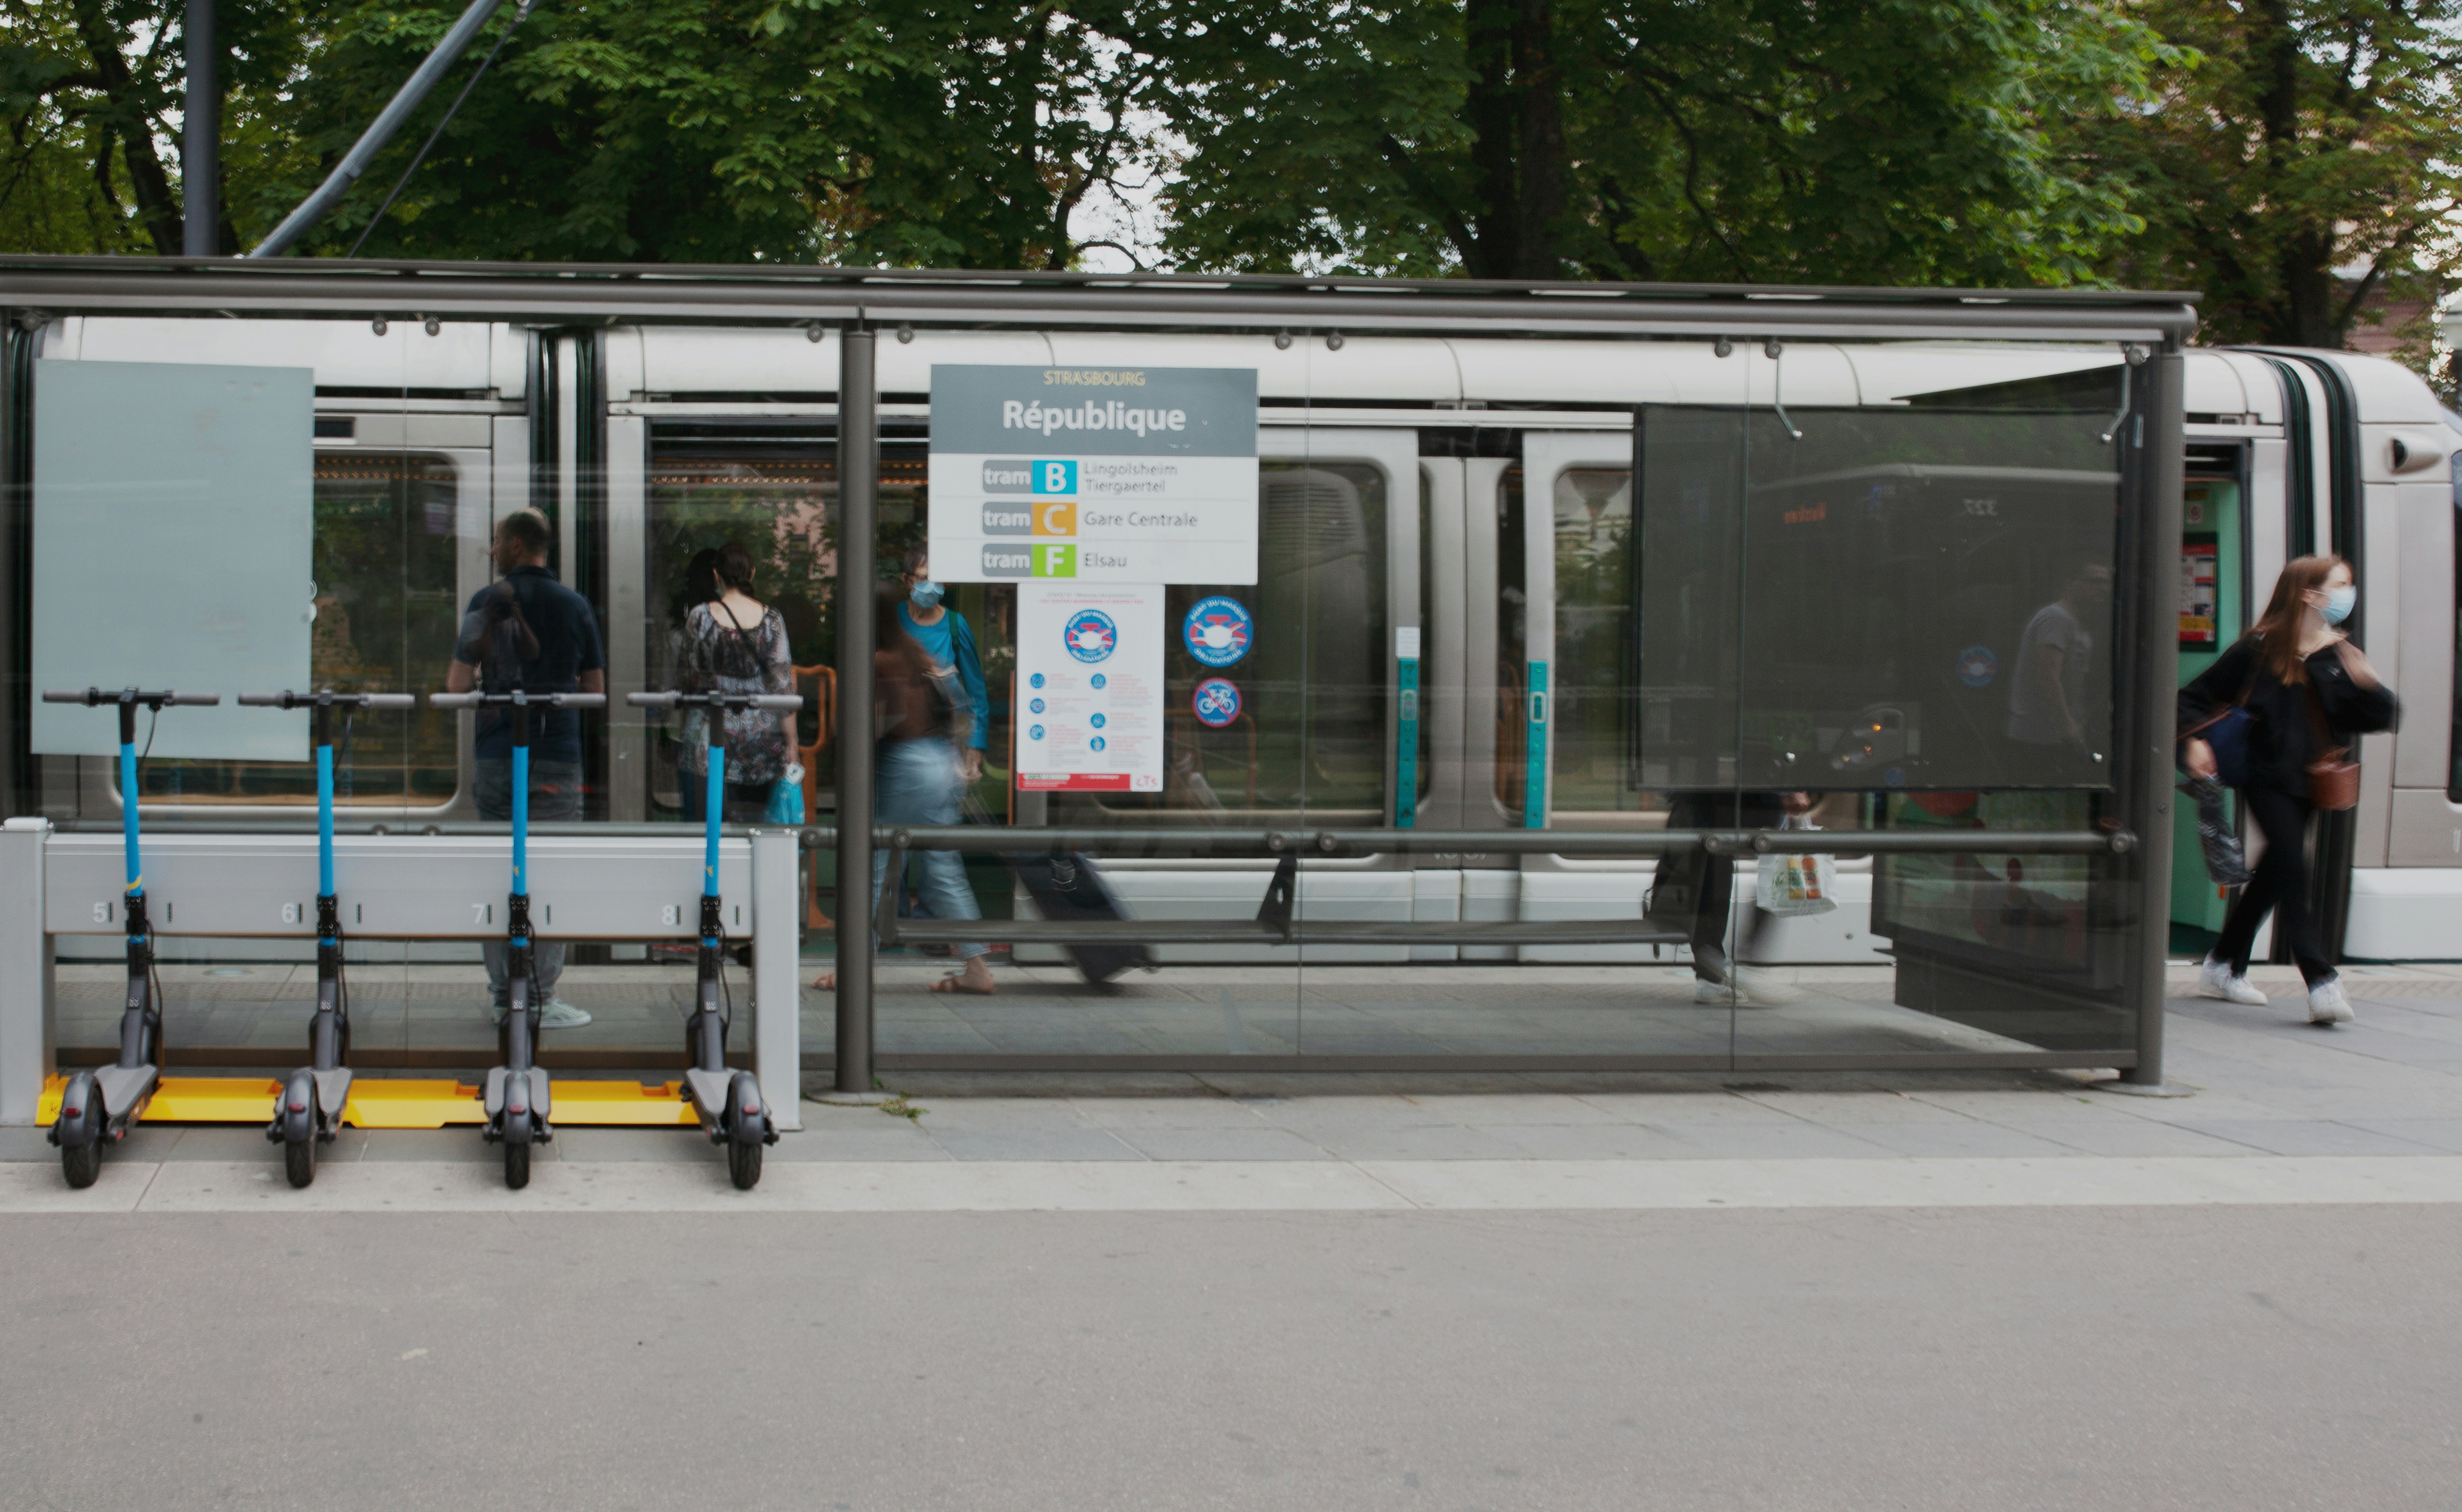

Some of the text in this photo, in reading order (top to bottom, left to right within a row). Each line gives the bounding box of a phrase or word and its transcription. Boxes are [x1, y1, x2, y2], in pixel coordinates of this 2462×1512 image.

[1043, 371, 1146, 386] STRASBOURG
[1003, 400, 1187, 438] République
[984, 463, 1066, 492] tram B
[1085, 462, 1178, 478] Lingolsheim
[1085, 479, 1165, 494] Tiergaertel
[983, 504, 1198, 534] tram C Gare Centrale
[983, 546, 1127, 576] tram F Elsau
[93, 902, 107, 923] 5
[281, 902, 296, 923] 6
[471, 903, 486, 924] 7
[661, 904, 675, 925] 8
